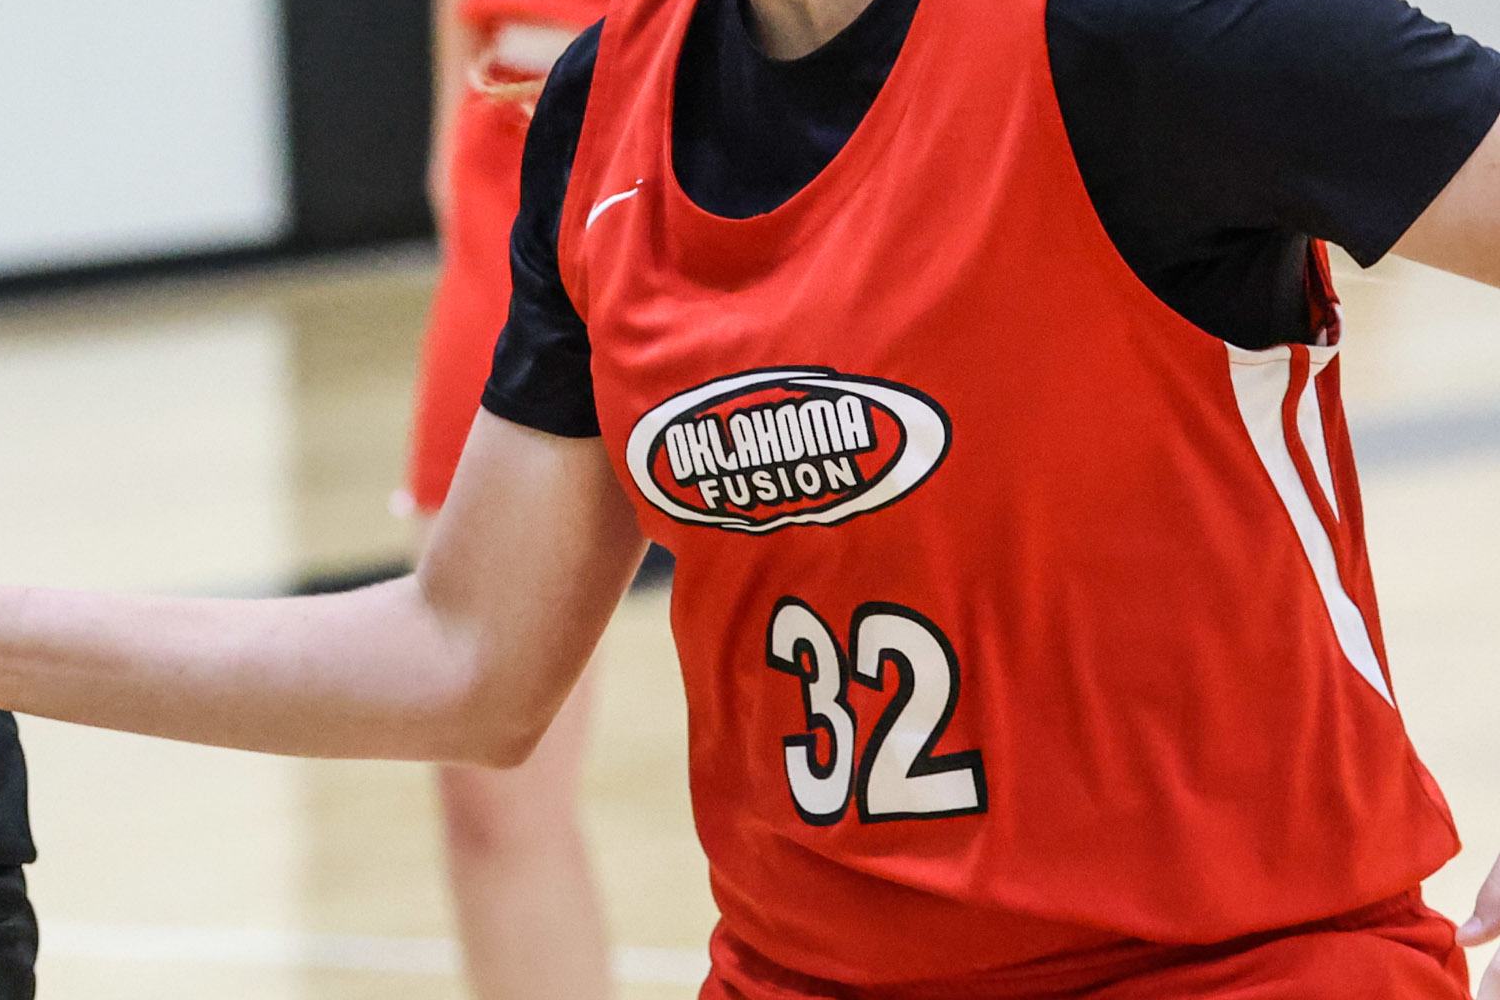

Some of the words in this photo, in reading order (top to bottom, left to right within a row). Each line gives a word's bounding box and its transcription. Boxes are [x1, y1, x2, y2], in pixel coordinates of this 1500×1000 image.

[664, 394, 872, 481] OKLAHOMA
[699, 457, 858, 510] FUSION
[767, 598, 986, 824] 32
